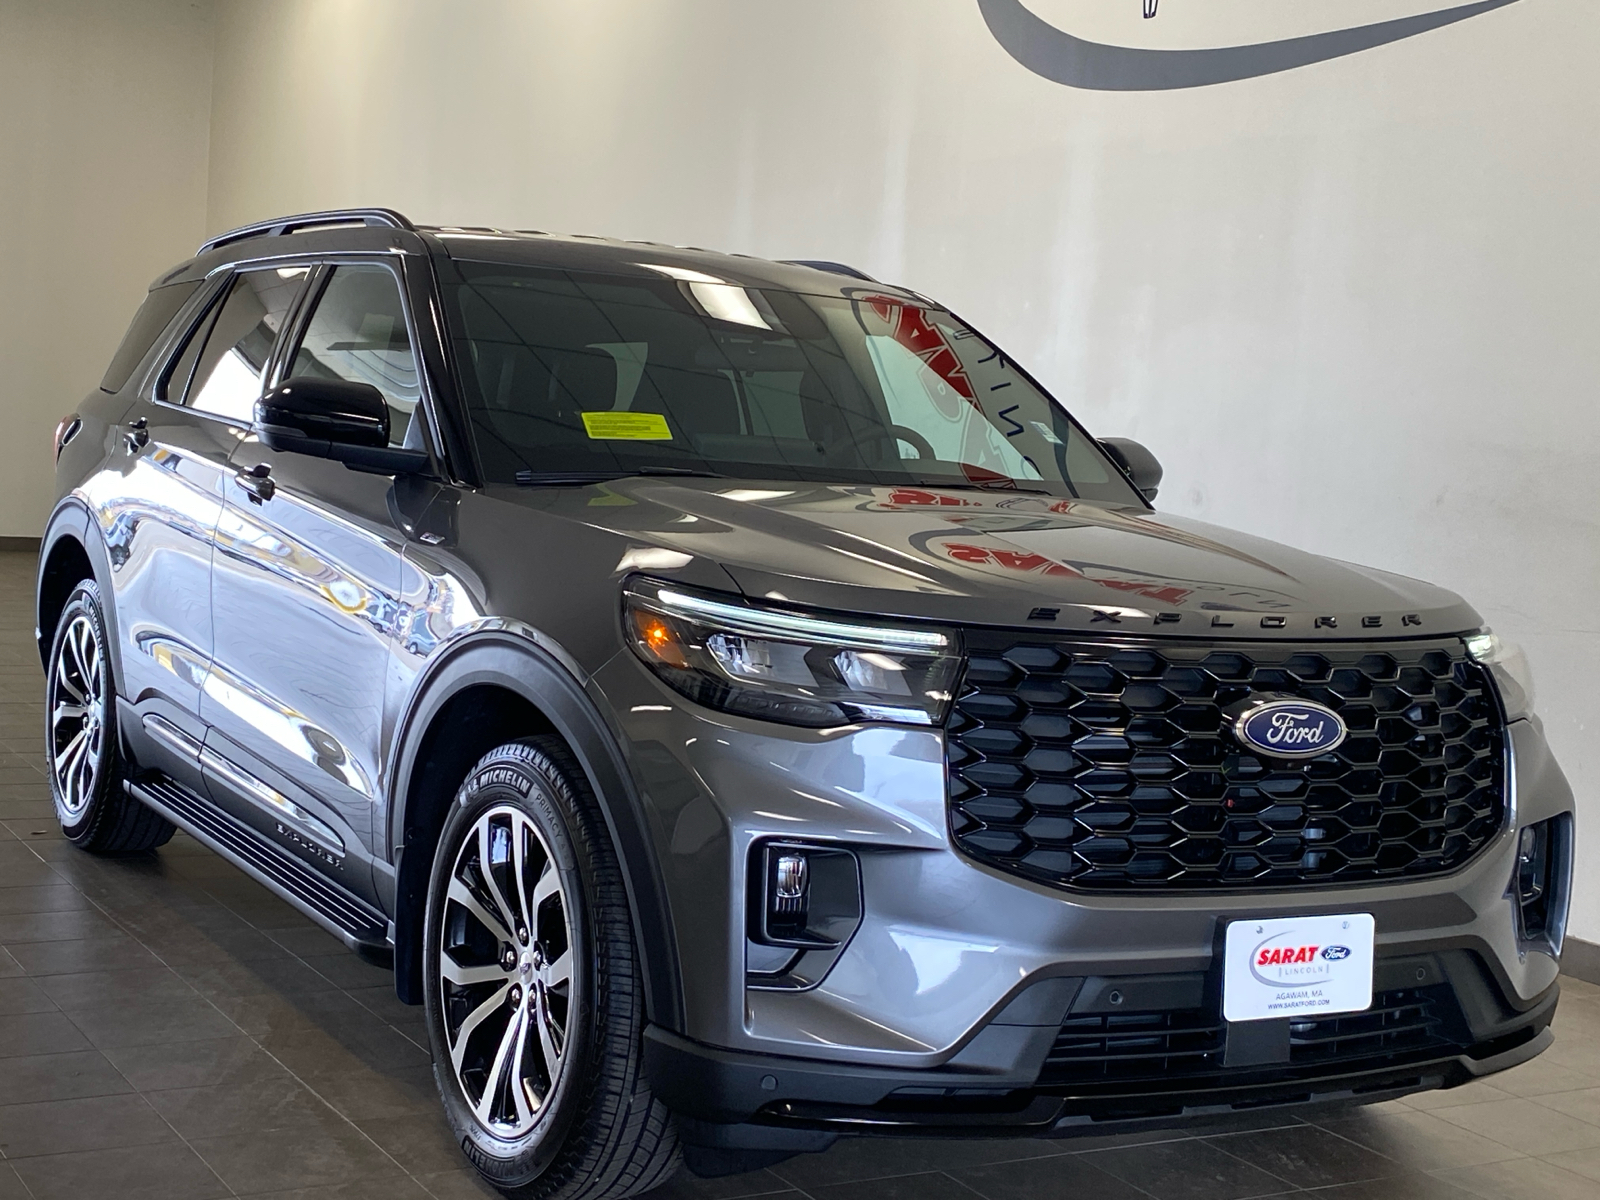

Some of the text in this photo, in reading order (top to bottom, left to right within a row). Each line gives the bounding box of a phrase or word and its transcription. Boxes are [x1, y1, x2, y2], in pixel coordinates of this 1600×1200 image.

[1027, 606, 1422, 630] EXPLORER
[1266, 712, 1324, 744] Ford
[480, 769, 530, 794] MICHELIN
[535, 793, 564, 839] PRIMACY
[1257, 945, 1319, 966] SARAT
[1285, 966, 1323, 976] LINCOLN
[1276, 989, 1323, 1000] AGAWAM, MA
